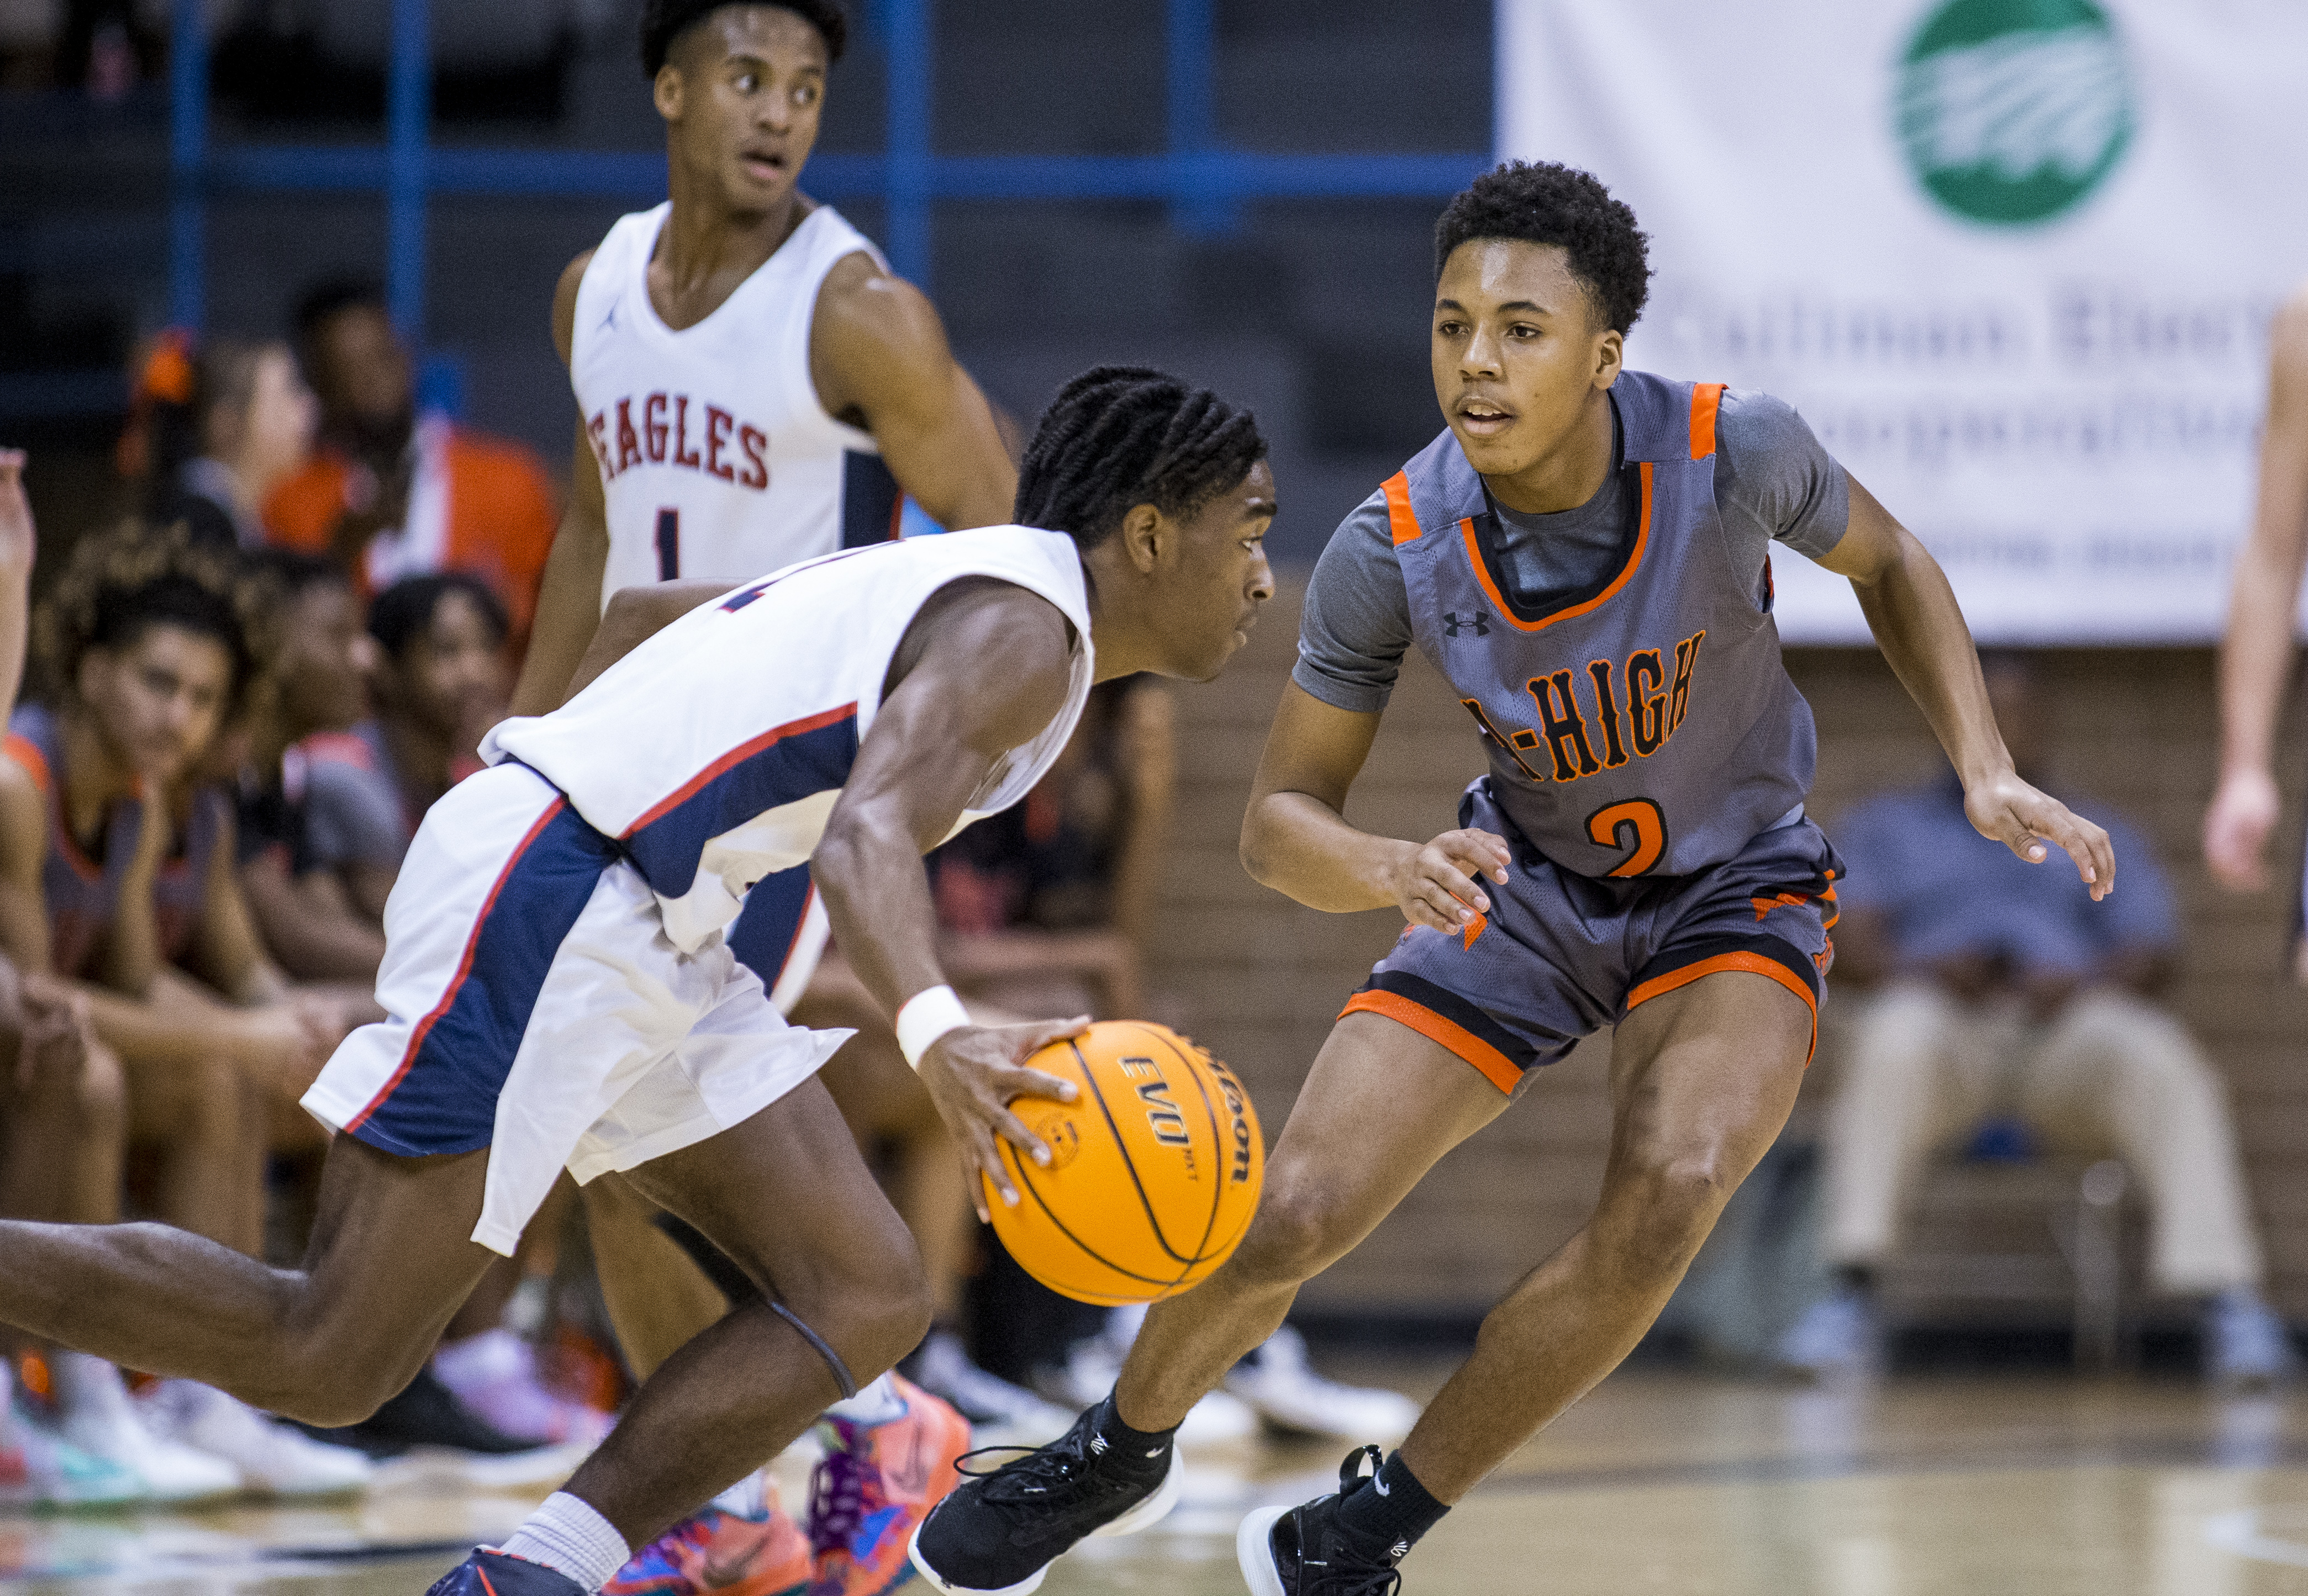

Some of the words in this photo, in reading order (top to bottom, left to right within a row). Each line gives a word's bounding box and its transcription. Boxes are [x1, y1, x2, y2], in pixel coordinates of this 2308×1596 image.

[586, 390, 769, 492] EAGLES
[651, 505, 680, 582] 1
[1583, 796, 1669, 877] 2
[1117, 1056, 1190, 1146] EVO
